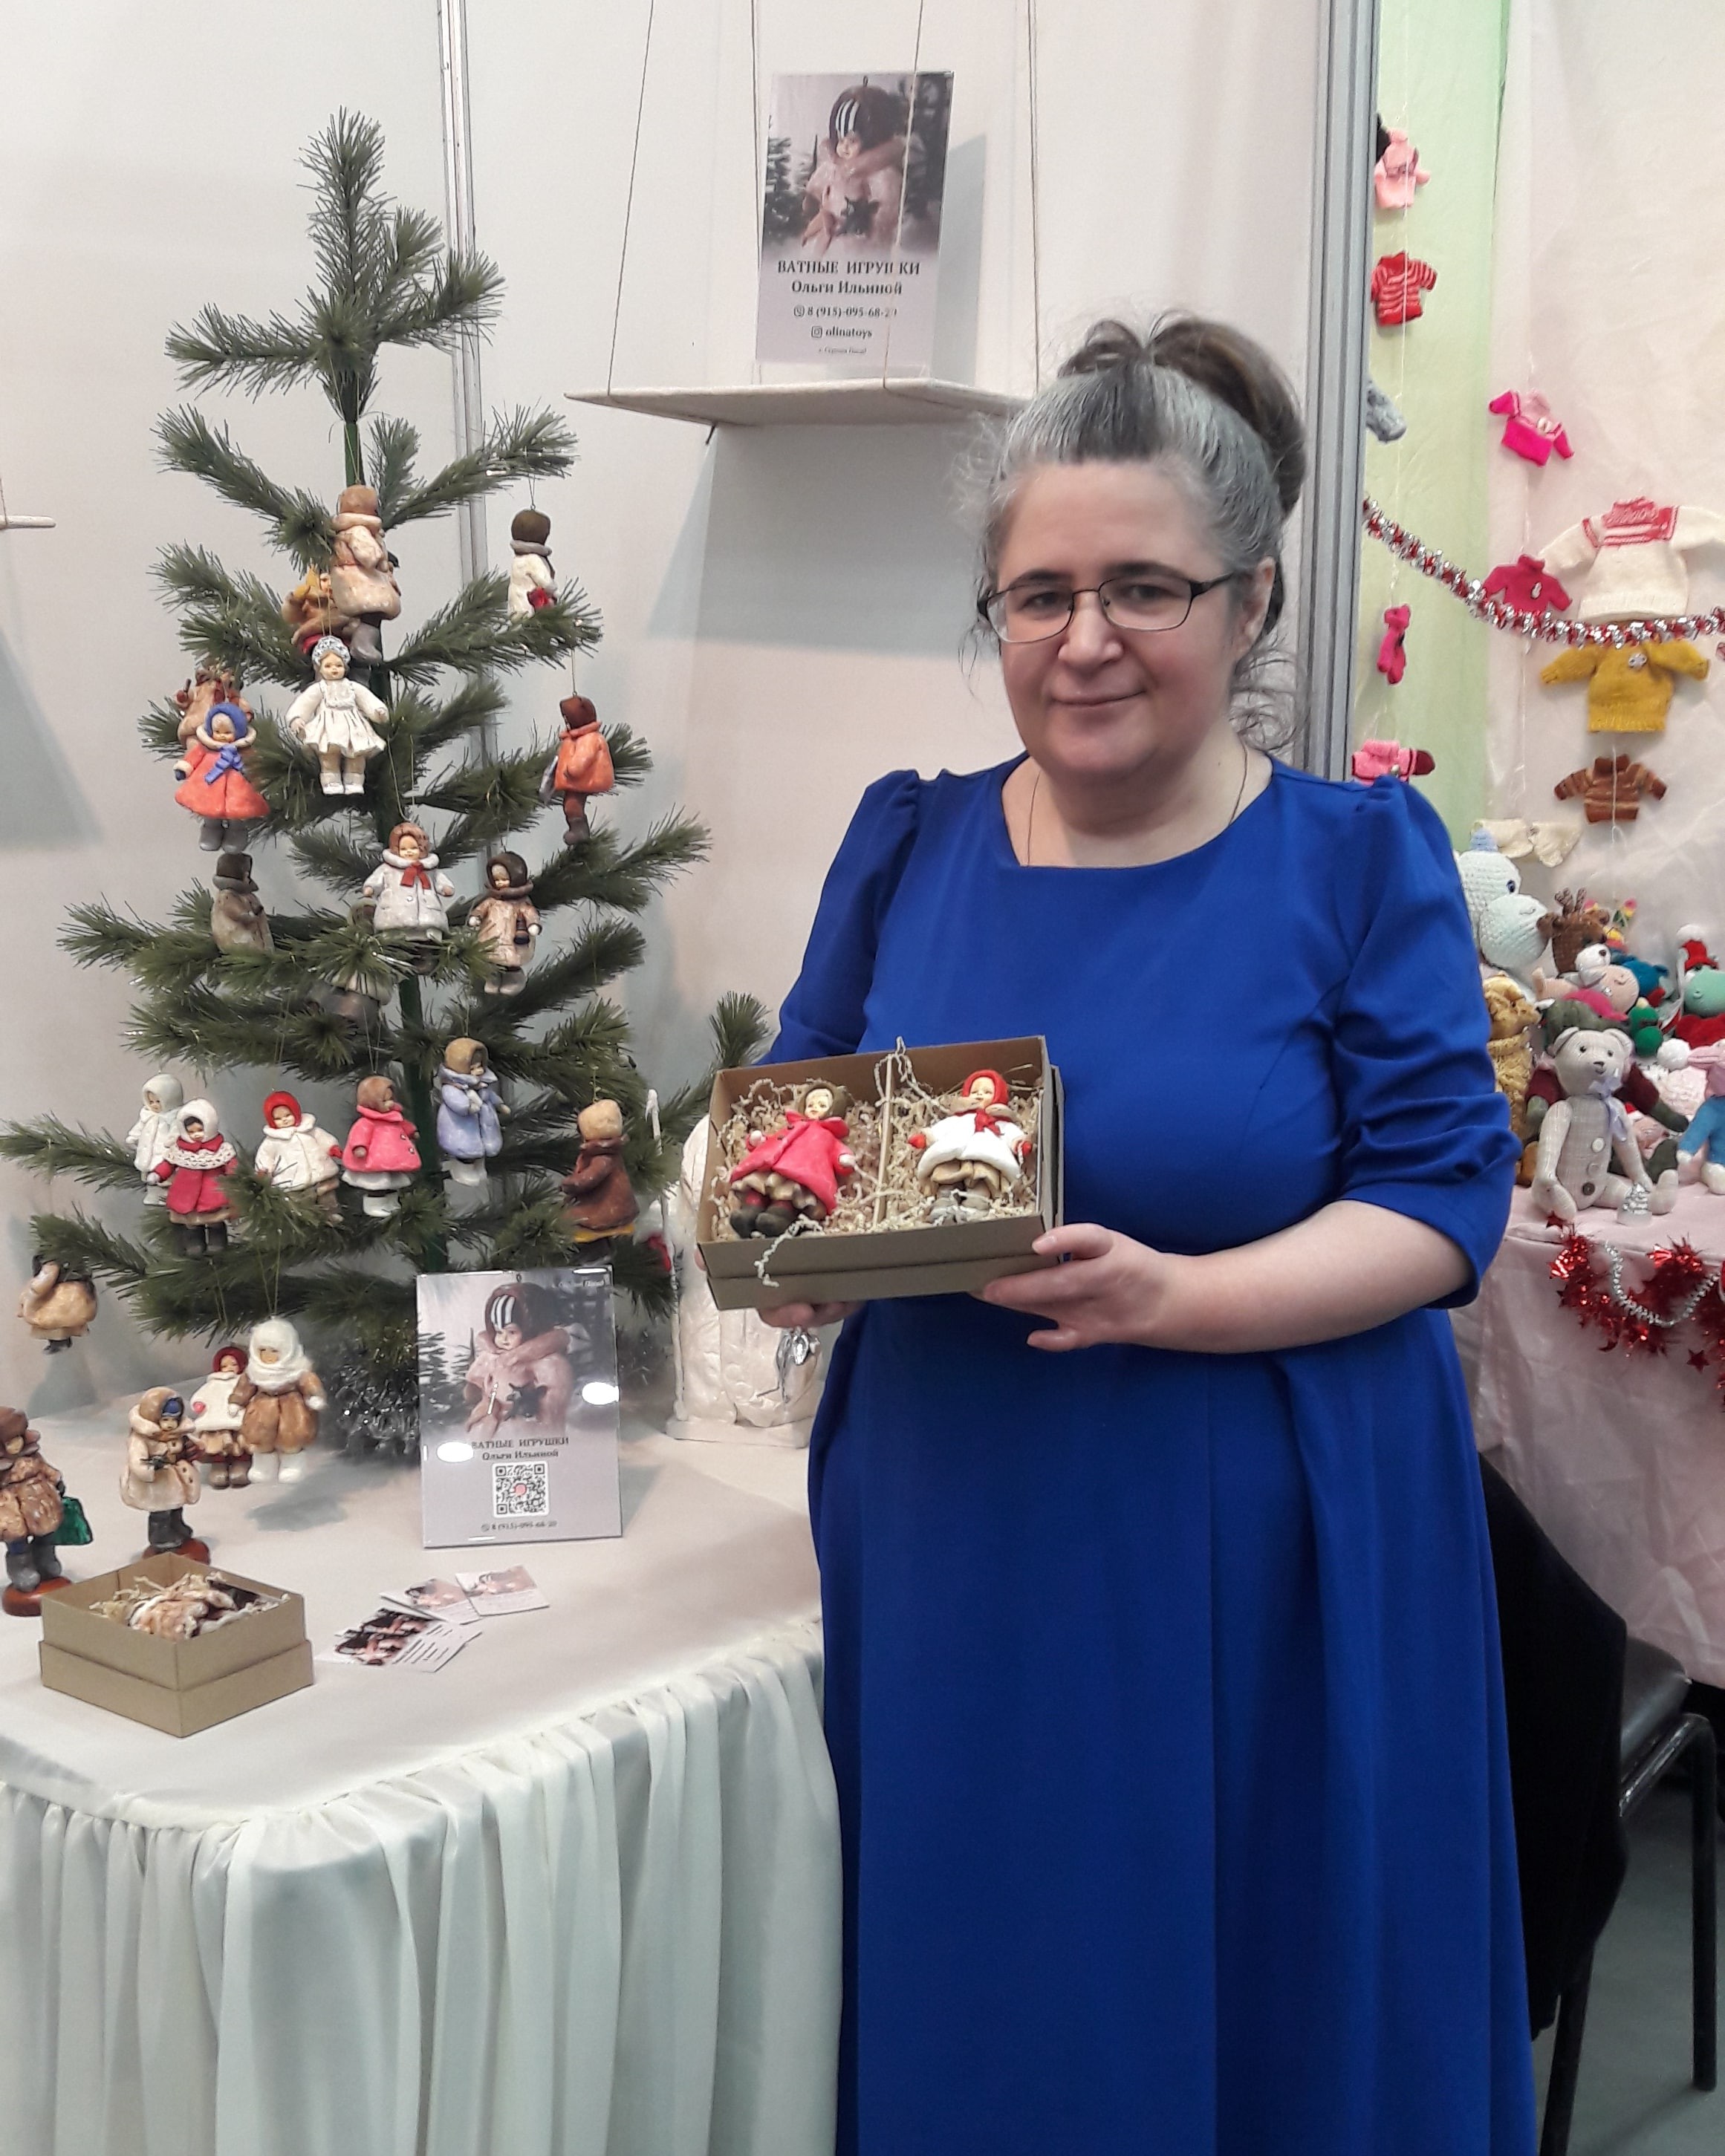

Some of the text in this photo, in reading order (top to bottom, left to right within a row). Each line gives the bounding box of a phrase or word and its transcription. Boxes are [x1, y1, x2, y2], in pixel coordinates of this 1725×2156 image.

[778, 261, 839, 274] ВАТНЫЕ
[791, 280, 902, 295] Ольги Ильиной
[808, 306, 813, 316] 8
[519, 1437, 569, 1447] ИГРУШКИ
